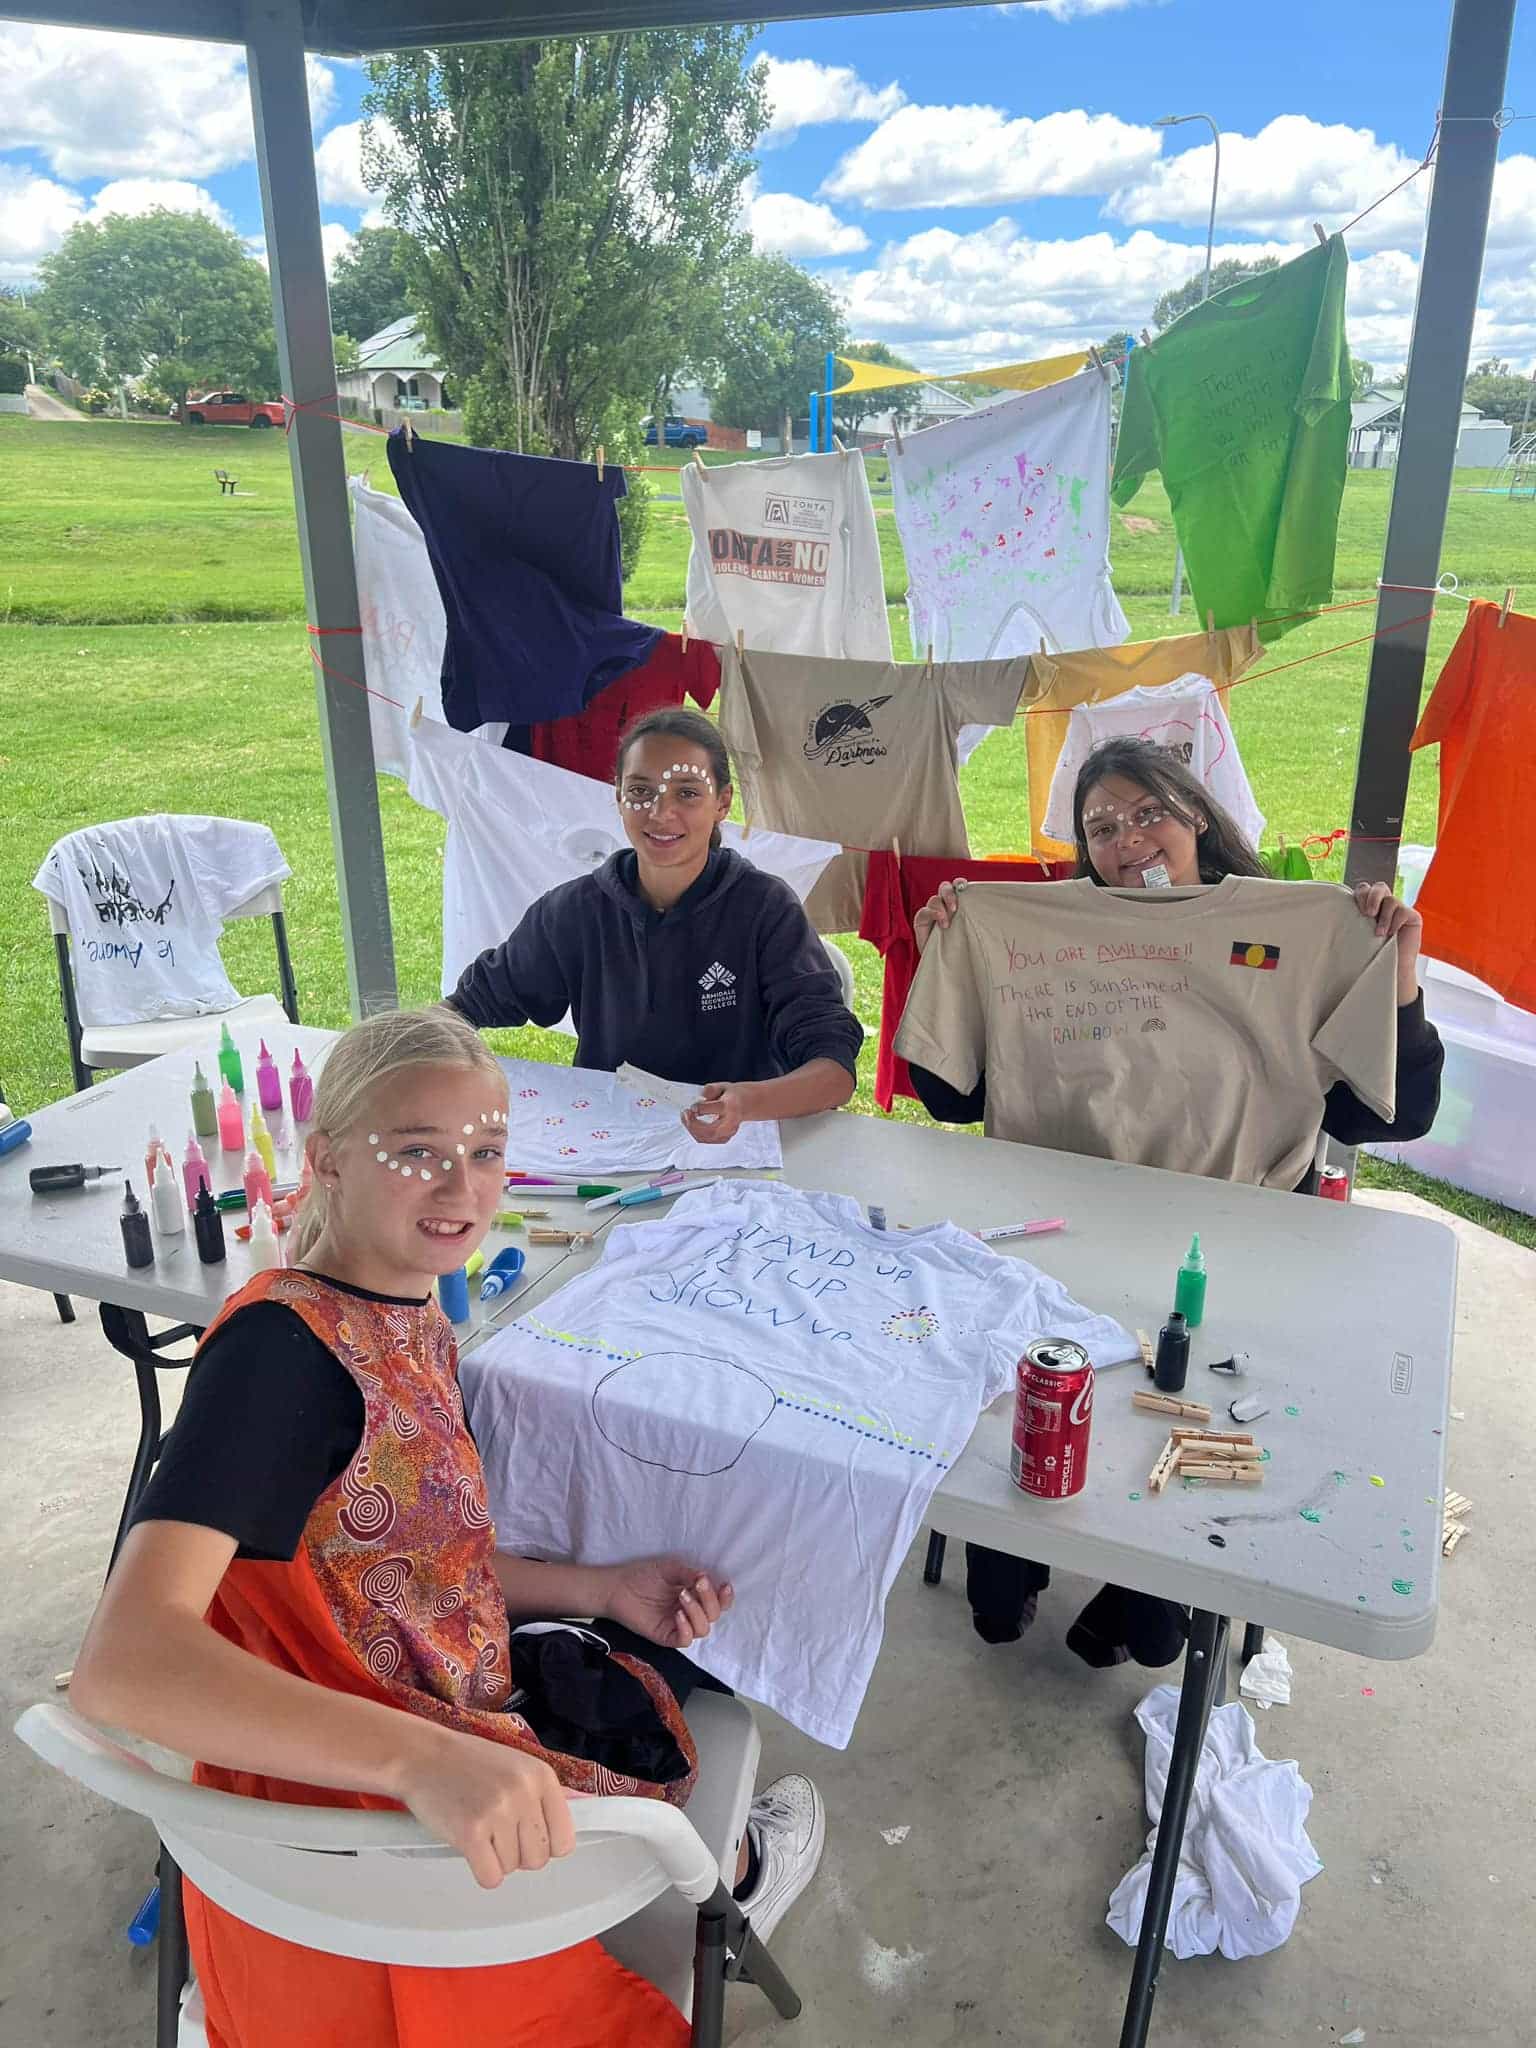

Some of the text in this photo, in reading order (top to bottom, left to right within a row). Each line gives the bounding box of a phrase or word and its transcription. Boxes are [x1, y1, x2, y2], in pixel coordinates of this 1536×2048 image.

[792, 501, 826, 512] ZONTA
[776, 542, 793, 567] SAYS
[794, 542, 830, 573] NO
[751, 569, 789, 582] AGAINST
[792, 572, 825, 586] WOMEN
[1066, 1001, 1097, 1018] END
[1129, 995, 1163, 1012] THE
